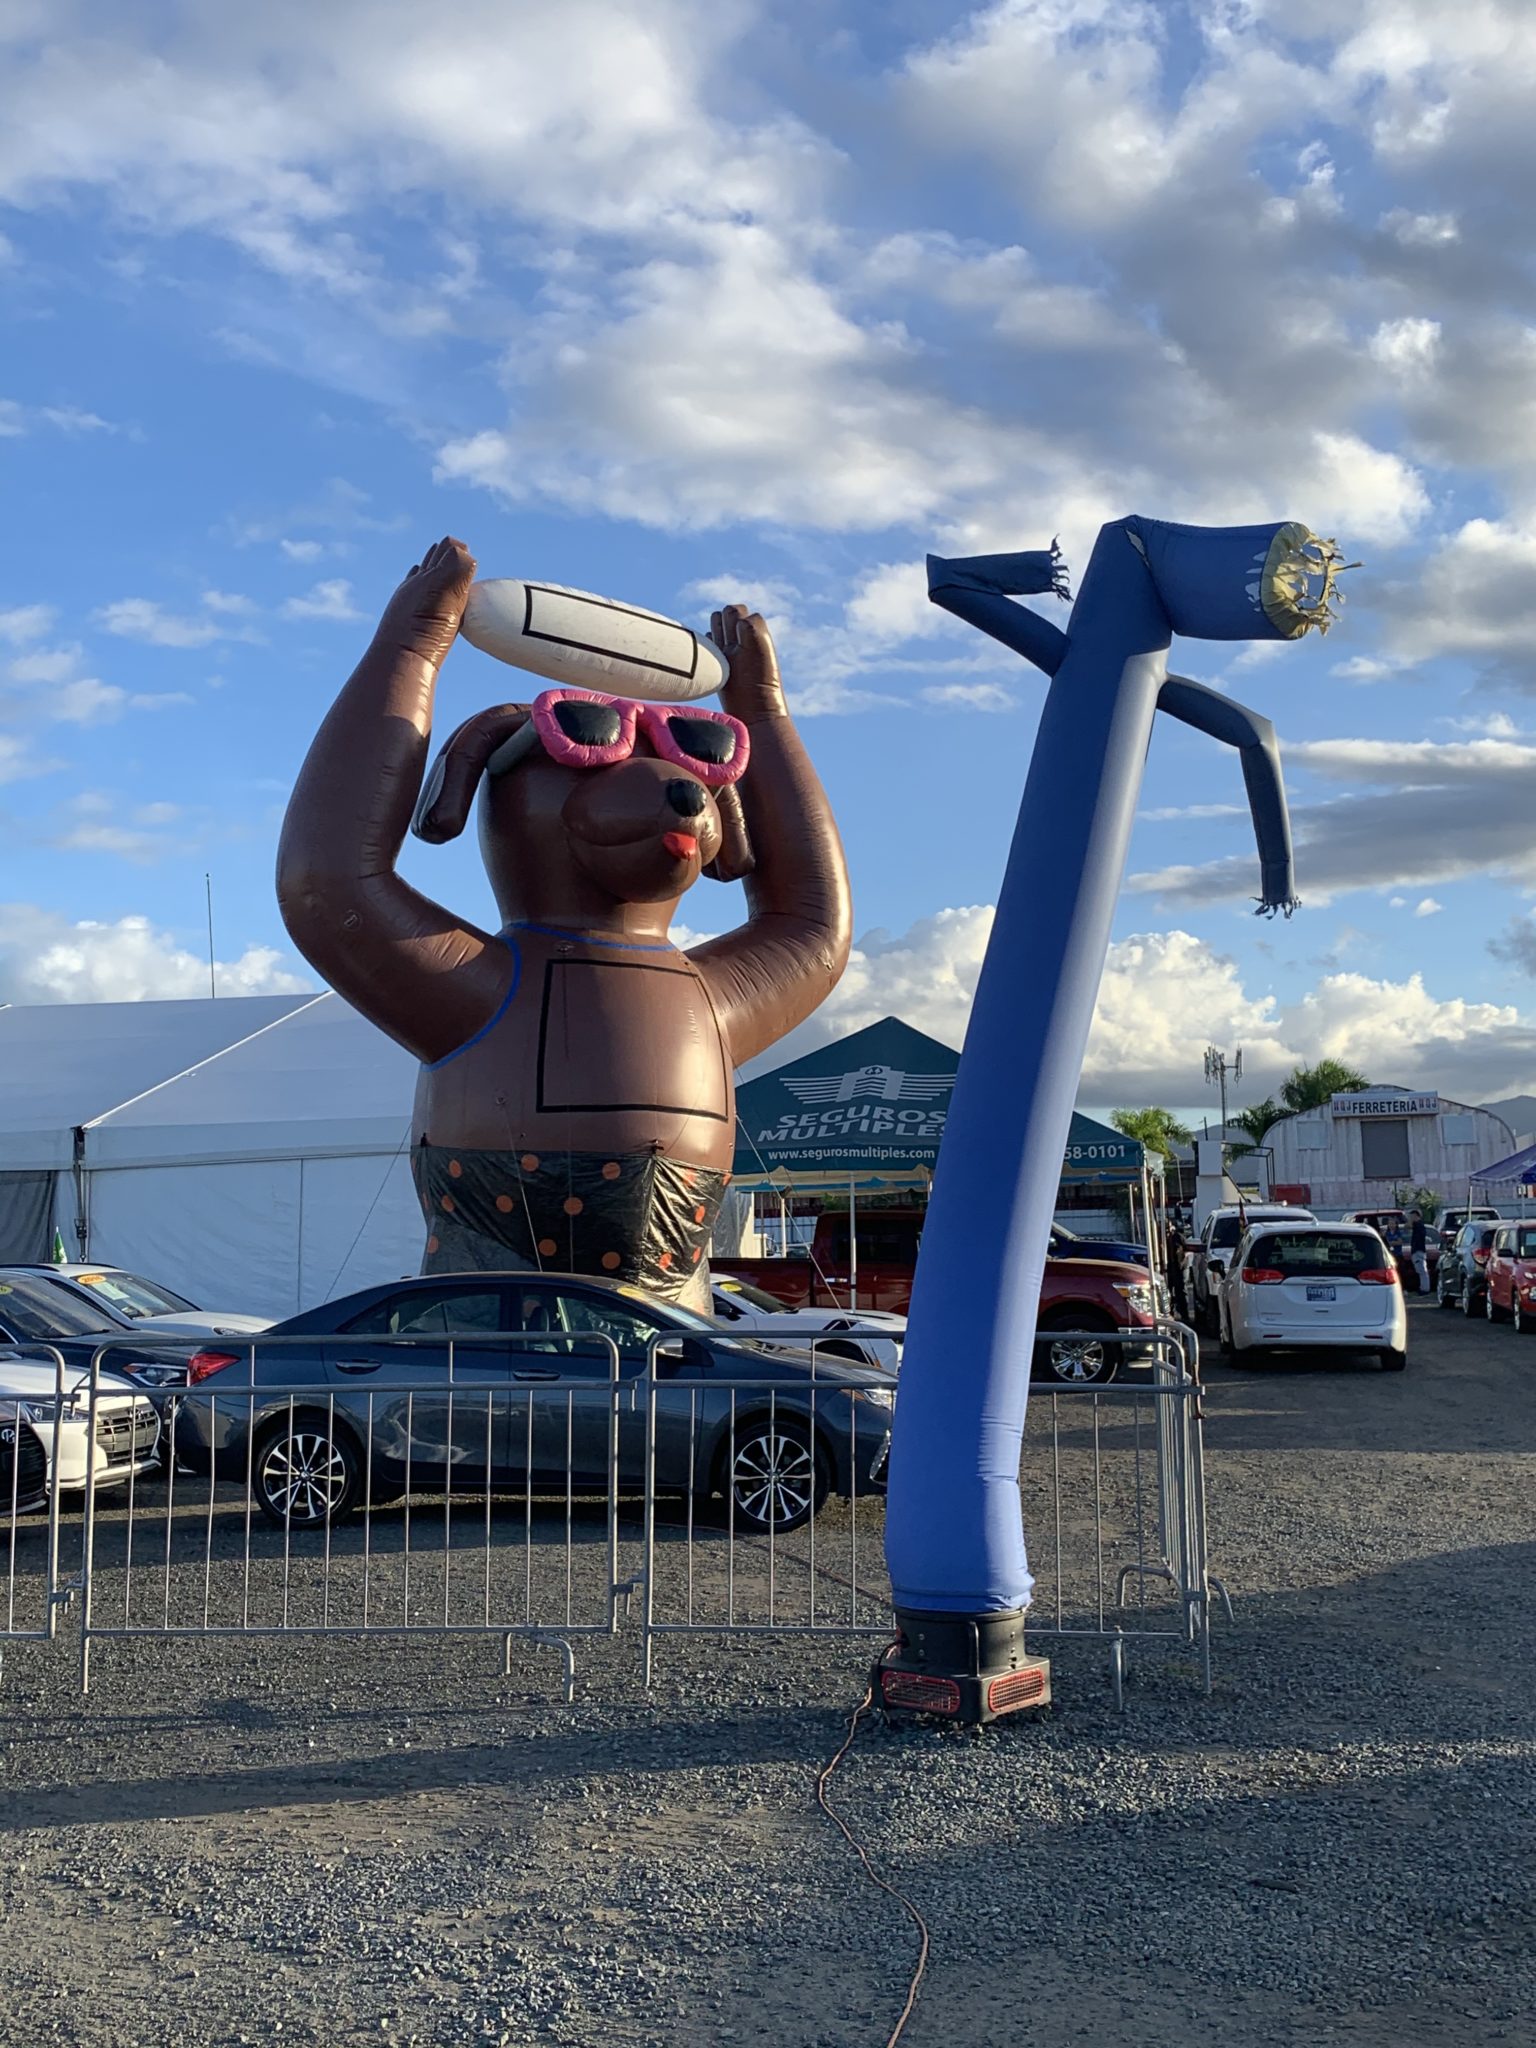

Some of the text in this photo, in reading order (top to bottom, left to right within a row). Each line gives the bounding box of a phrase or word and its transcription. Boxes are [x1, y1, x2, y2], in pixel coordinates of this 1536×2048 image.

[1352, 1100, 1417, 1114] FERRETERIA
[777, 1105, 946, 1128] SEGUROS
[768, 1147, 935, 1161] www.segurosmultiples.com
